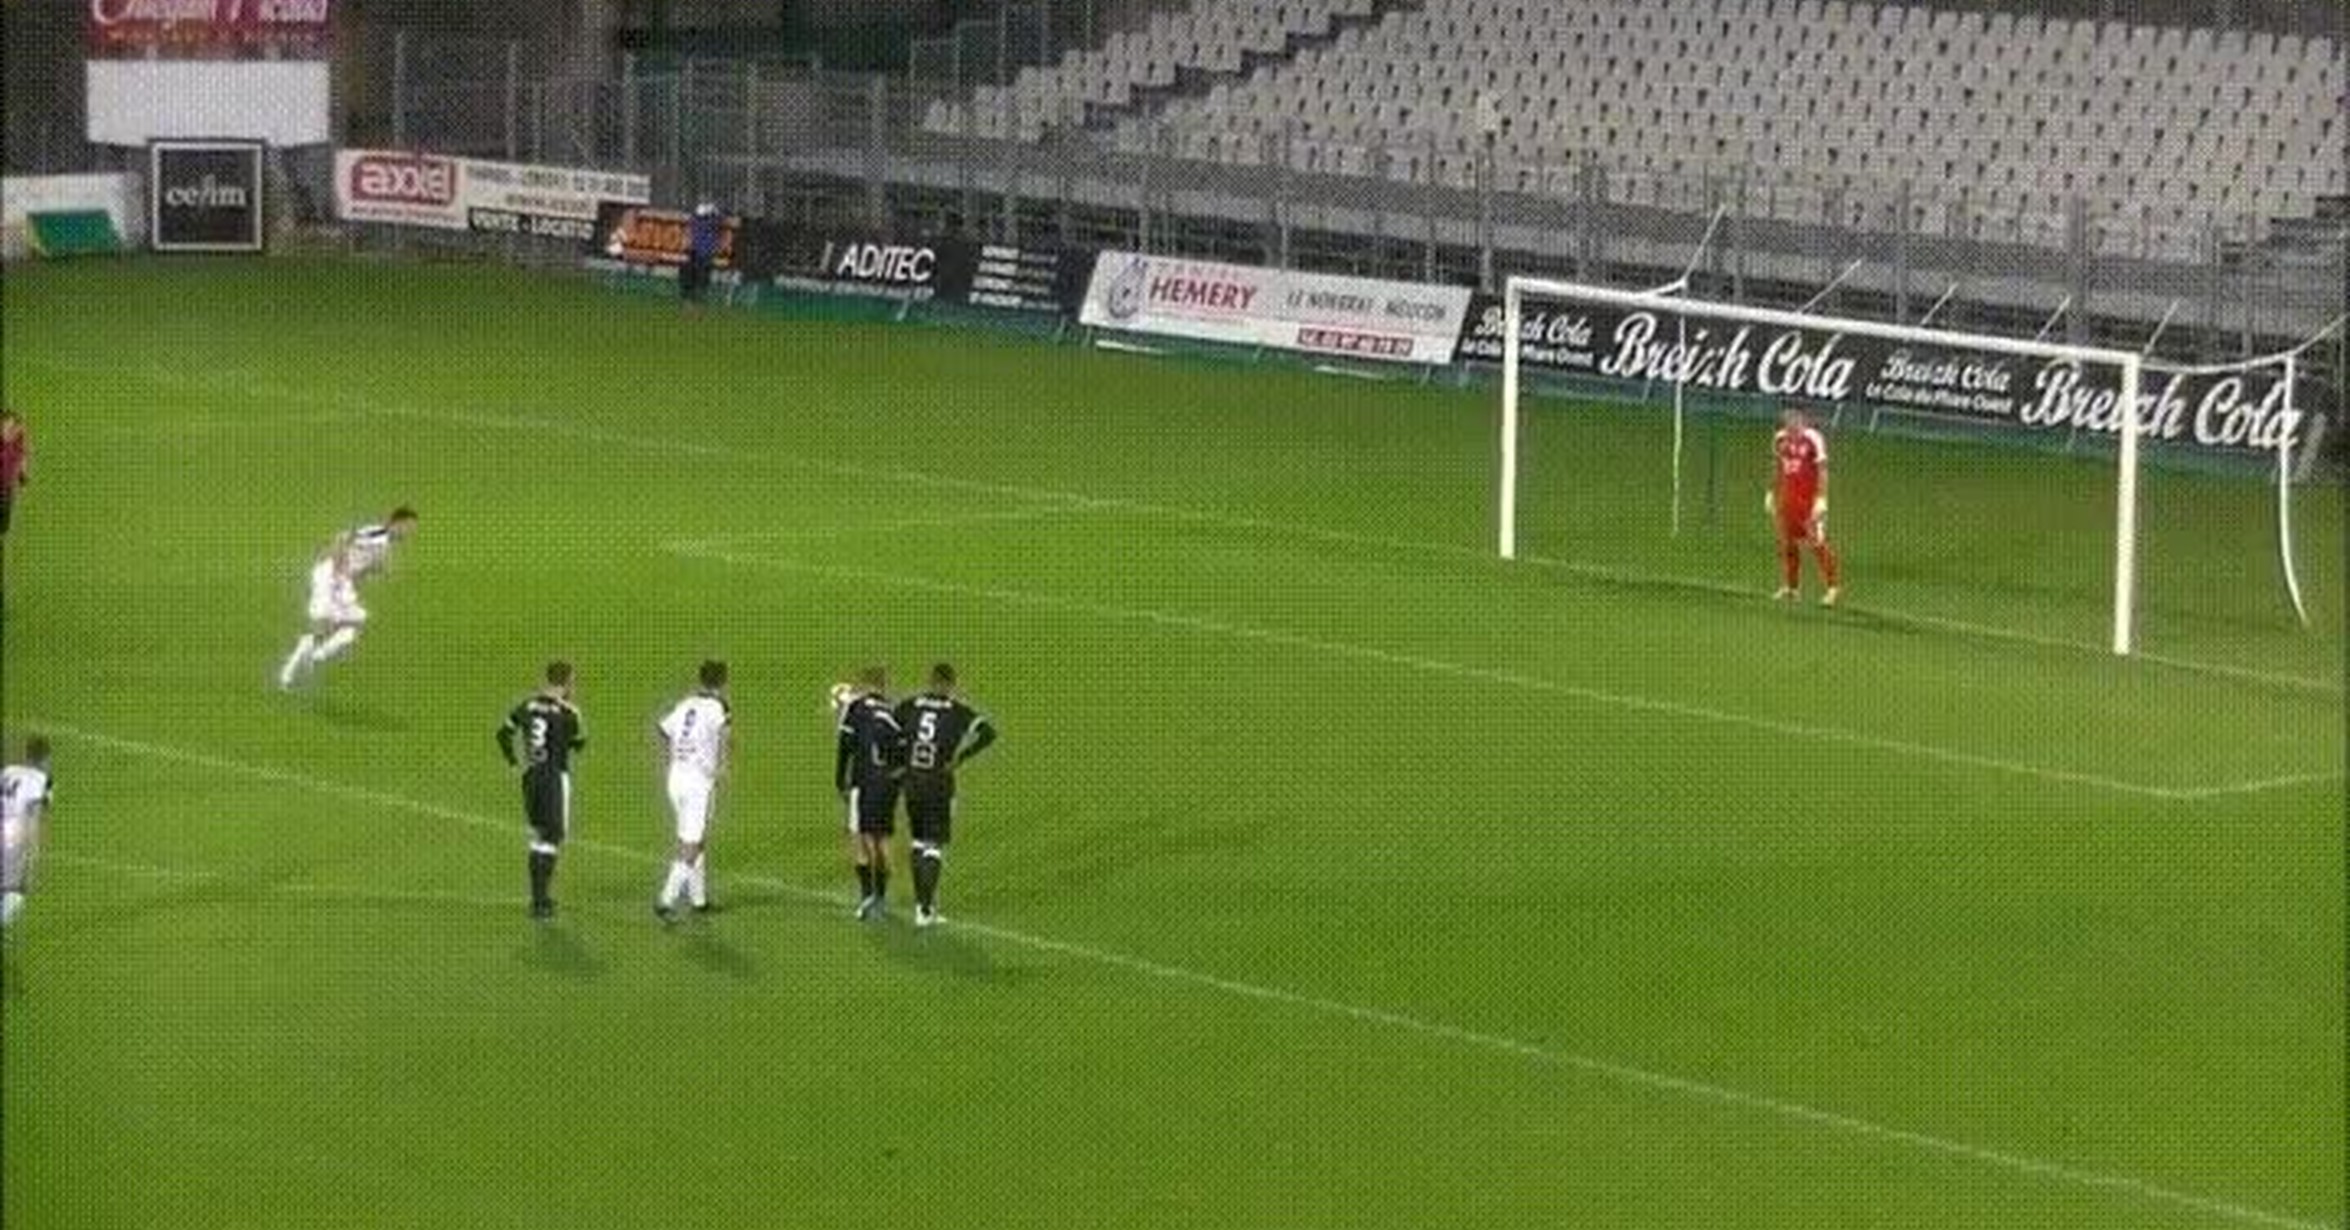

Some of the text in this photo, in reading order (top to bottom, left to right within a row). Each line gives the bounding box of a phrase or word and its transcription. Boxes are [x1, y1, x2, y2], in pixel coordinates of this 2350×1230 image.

[836, 243, 936, 283] ADITEC
[1150, 275, 1259, 310] HEMERY
[1474, 306, 1593, 346] Brzh Cola
[1599, 312, 1857, 400] Breizh Cola
[1960, 354, 2014, 393] Cola
[2194, 376, 2306, 449] Cola
[530, 716, 548, 748] 3
[917, 710, 938, 741] 5
